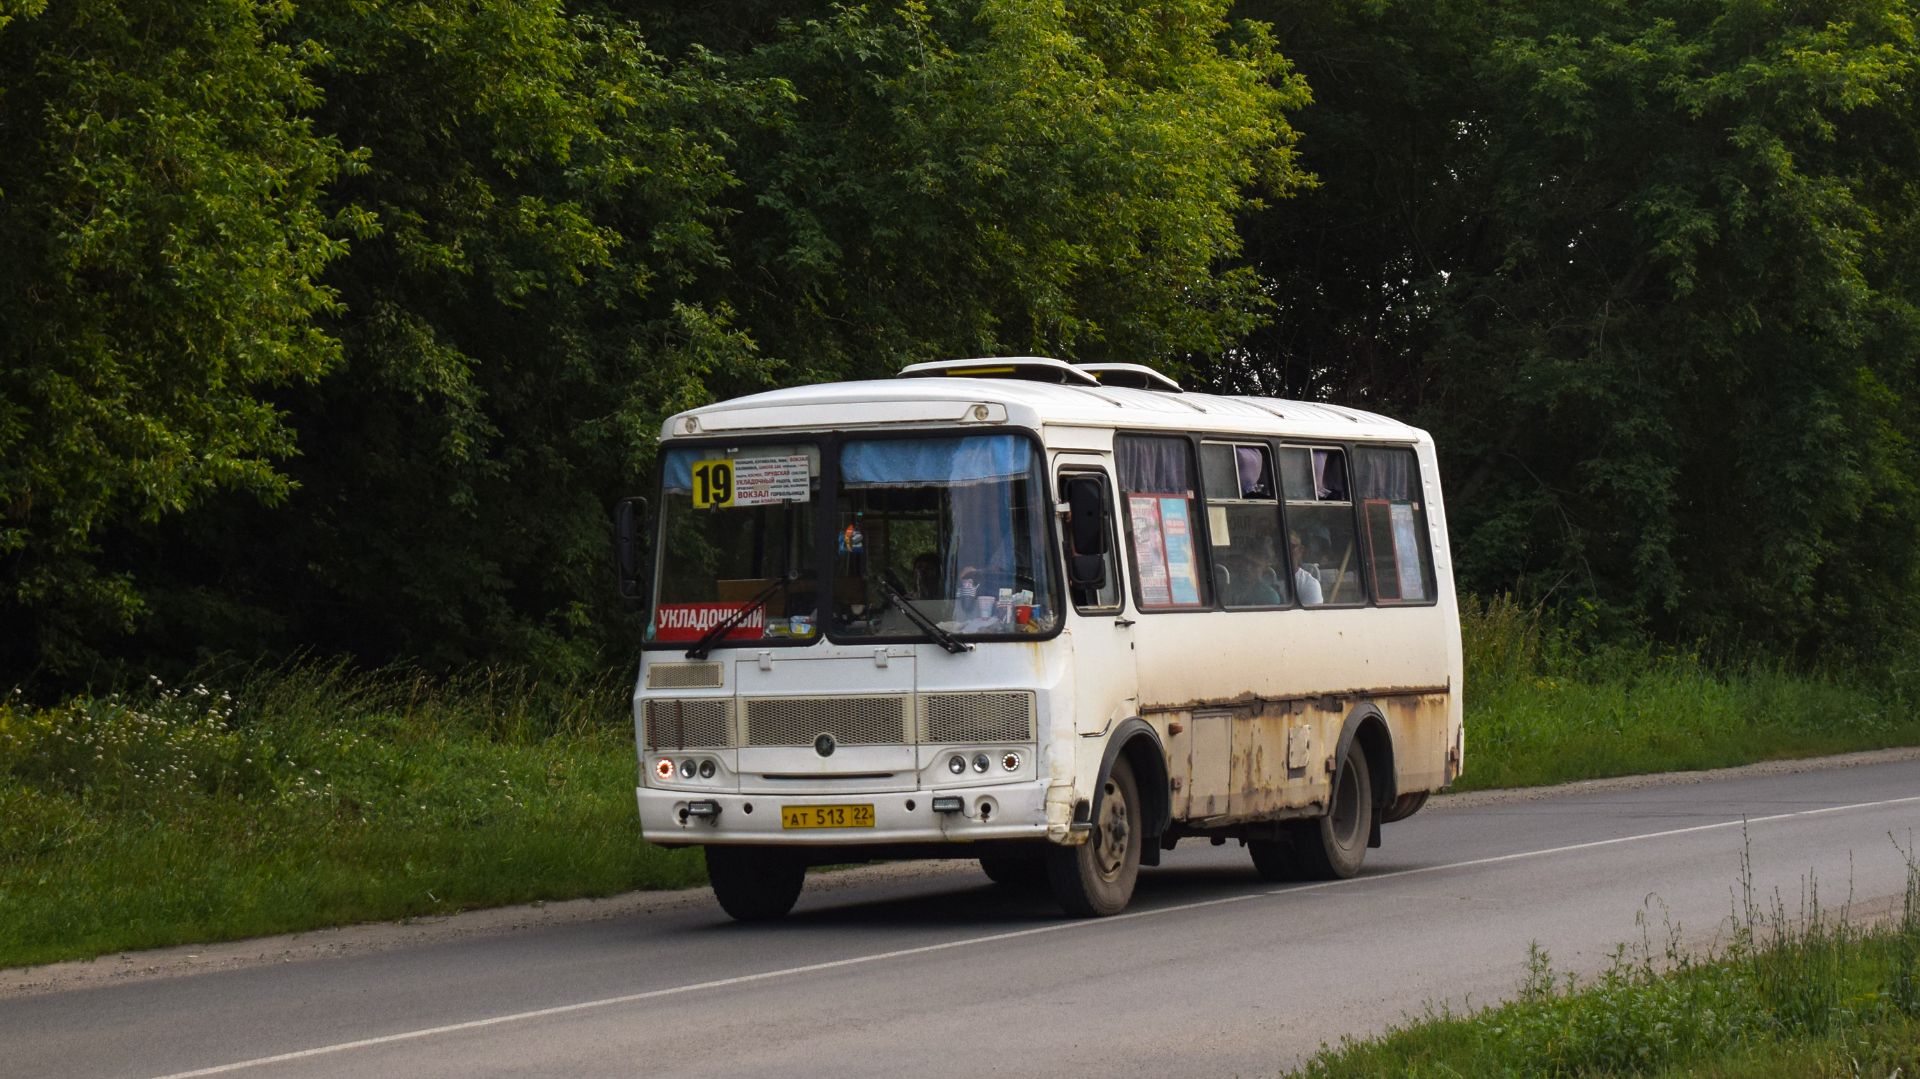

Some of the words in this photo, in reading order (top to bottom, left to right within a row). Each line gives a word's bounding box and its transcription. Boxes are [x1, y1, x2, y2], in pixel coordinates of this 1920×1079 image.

[695, 464, 732, 503] 19
[736, 477, 775, 486] УКЛАДОЧНЫЙ
[737, 490, 769, 499] ВОКЗАЛ
[816, 808, 845, 825] 513
[854, 807, 869, 820] 22
